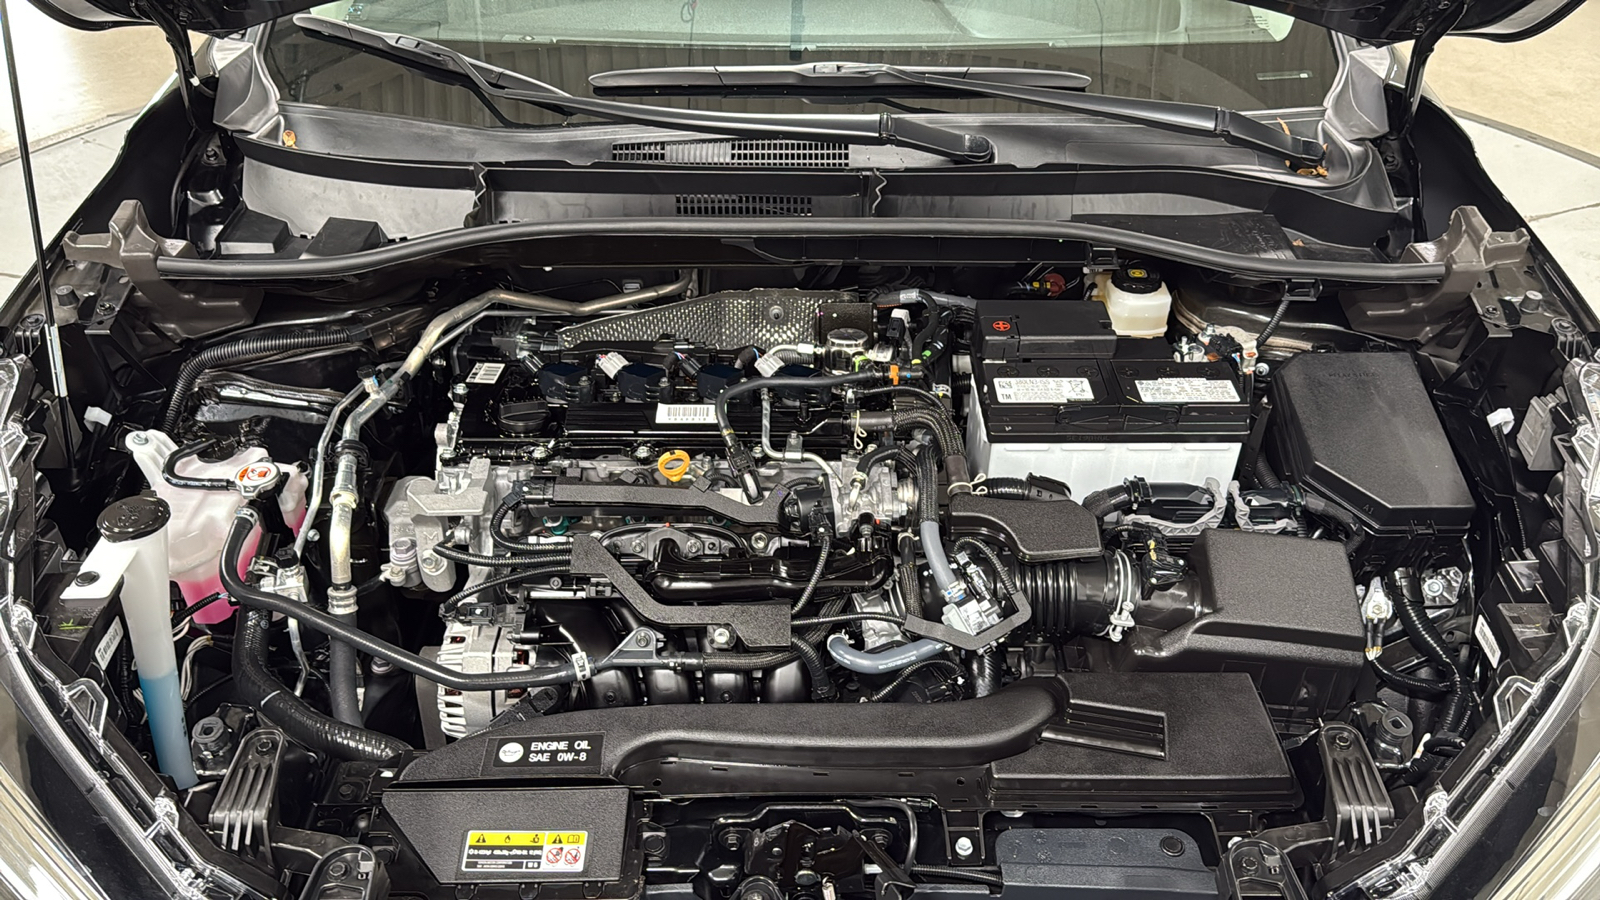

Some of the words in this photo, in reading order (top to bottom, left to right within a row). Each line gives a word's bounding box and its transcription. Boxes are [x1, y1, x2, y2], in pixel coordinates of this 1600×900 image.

[530, 741, 569, 751] ENGINE
[574, 740, 591, 750] OIL
[529, 753, 551, 762] SAE
[557, 752, 587, 762] 0W-8
